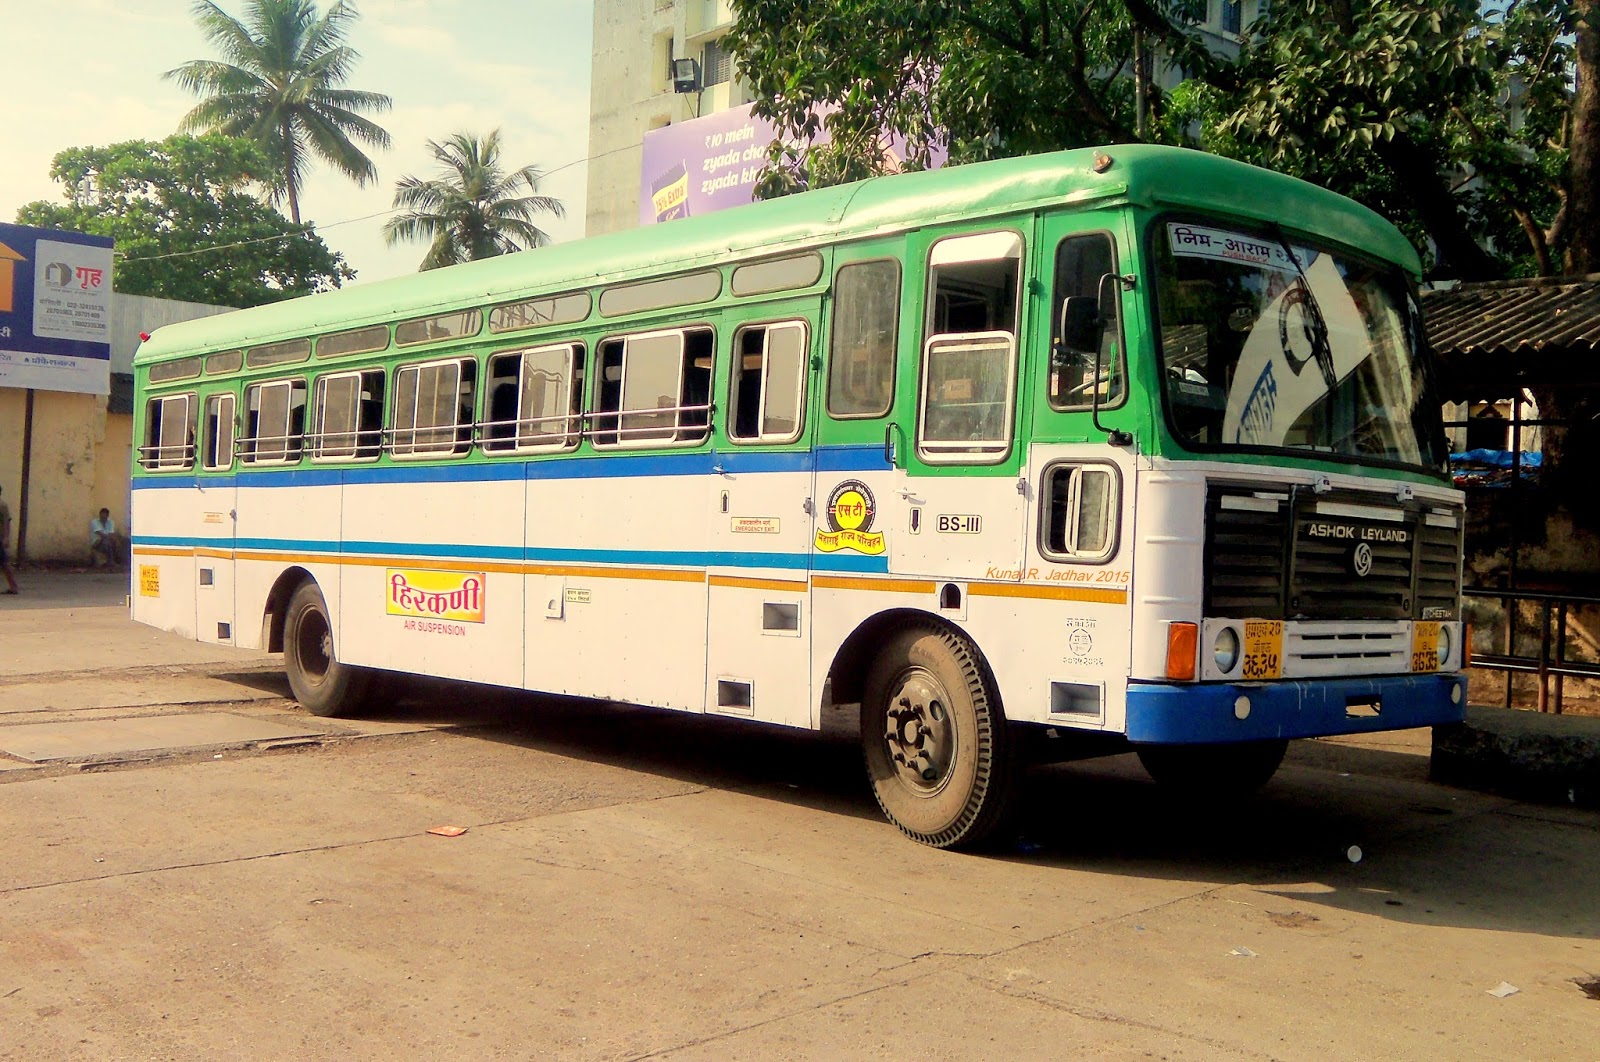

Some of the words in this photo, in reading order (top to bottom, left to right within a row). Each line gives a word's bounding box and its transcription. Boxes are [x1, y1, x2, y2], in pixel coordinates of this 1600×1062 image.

[724, 122, 755, 144] mein
[703, 148, 740, 173] zyada
[701, 170, 739, 196] zyada
[1222, 250, 1245, 260] PUSH
[1246, 255, 1268, 264] BACK
[75, 266, 103, 290] गृह
[939, 516, 979, 532] BS-III
[1309, 523, 1355, 539] ASHOK
[1361, 528, 1407, 542] LEYLAND
[390, 573, 480, 615] हिरकणी
[404, 620, 416, 631] AIR
[418, 621, 466, 636] SUSPENSION
